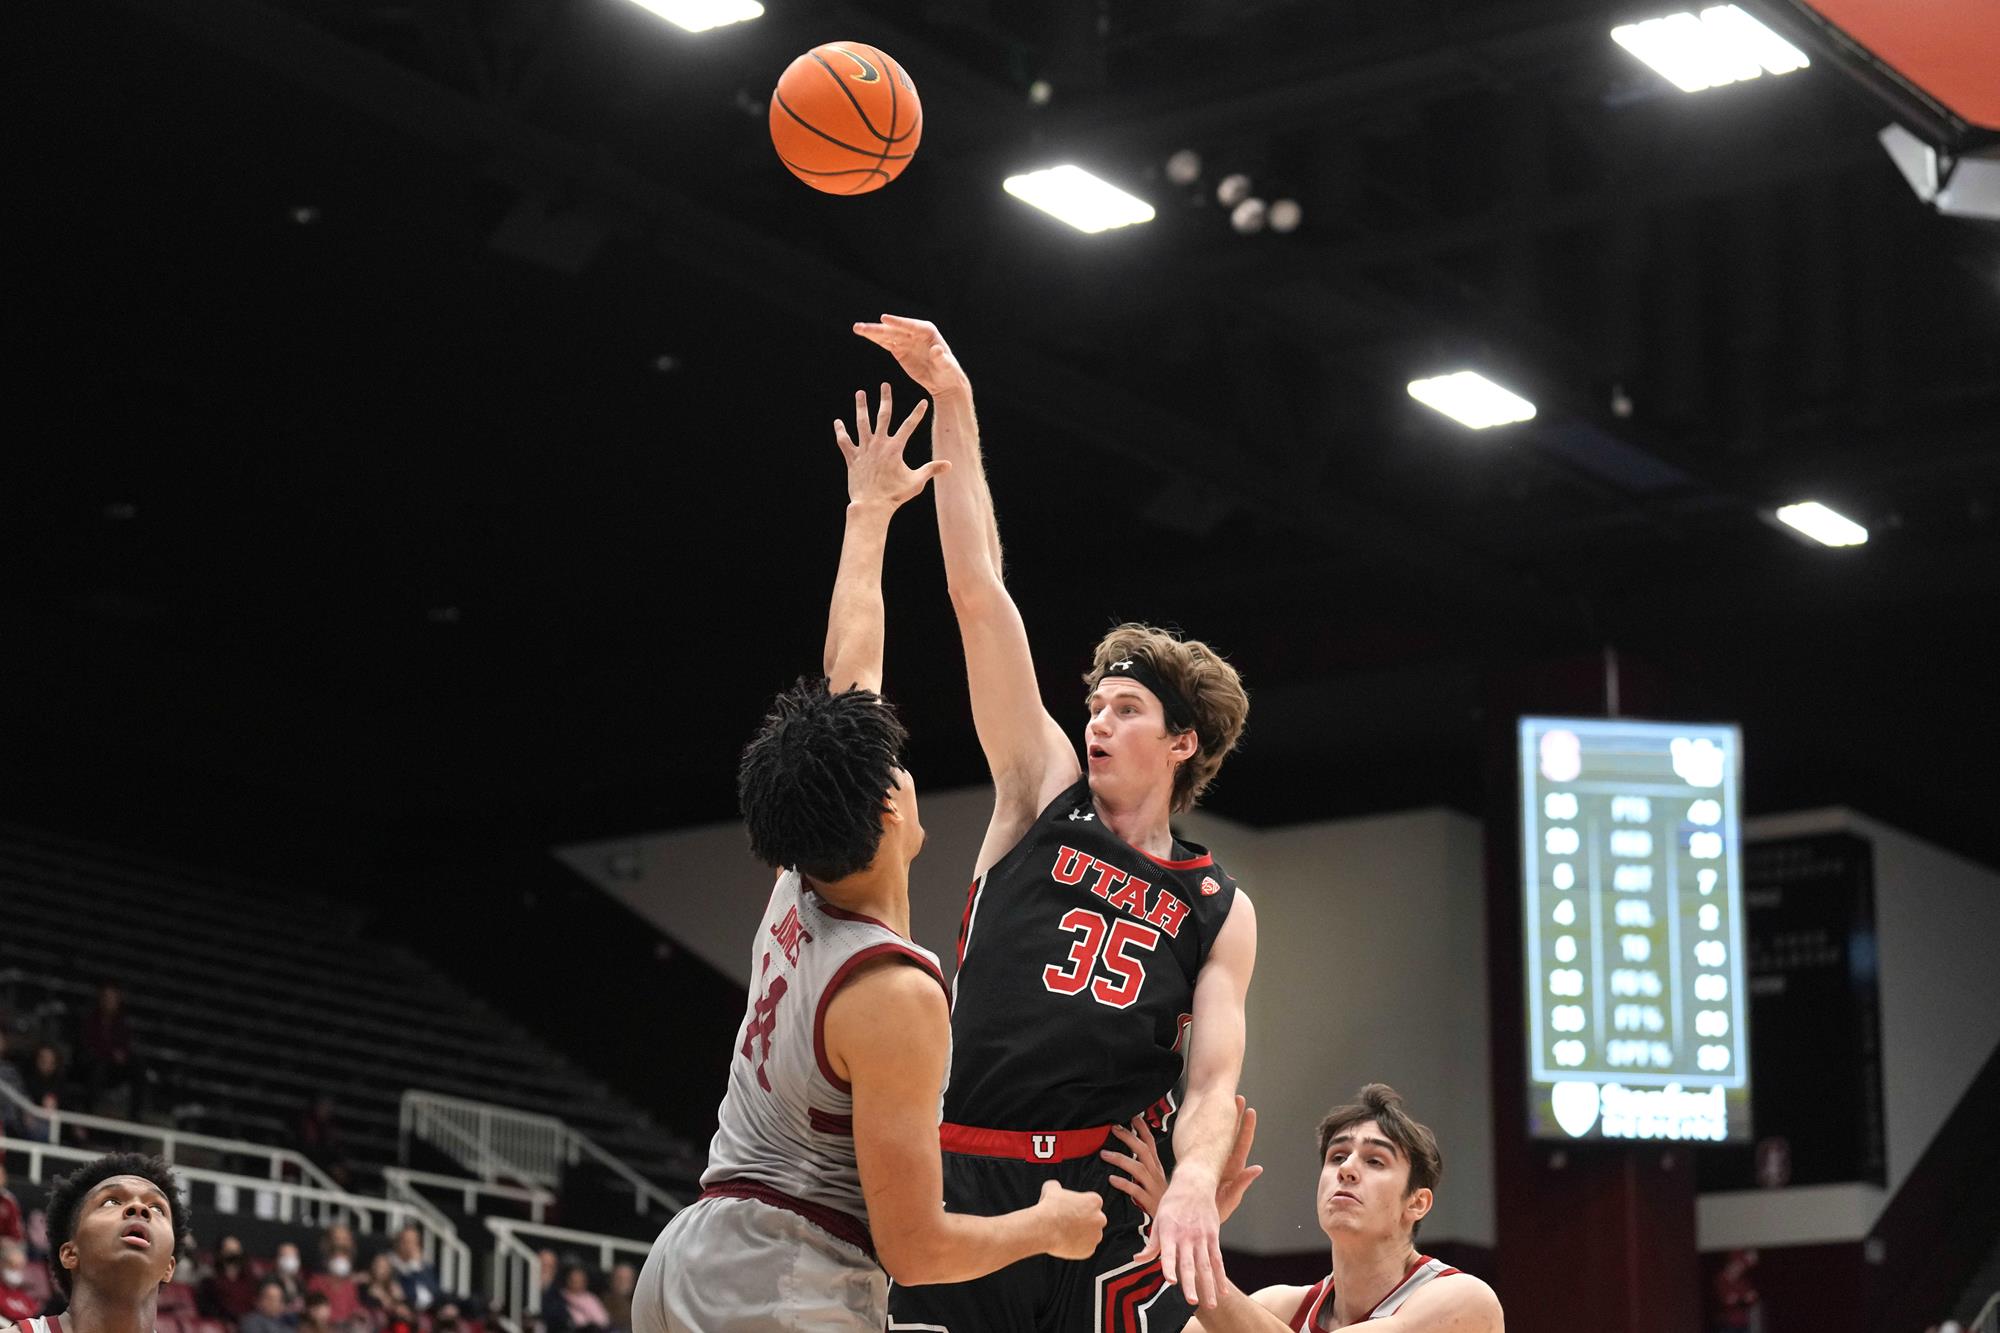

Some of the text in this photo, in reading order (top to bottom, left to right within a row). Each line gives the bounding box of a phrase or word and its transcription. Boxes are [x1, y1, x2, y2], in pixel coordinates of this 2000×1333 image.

[1051, 845, 1191, 938] UTAH
[1042, 908, 1161, 1010] 35
[1032, 1135, 1056, 1159] U
